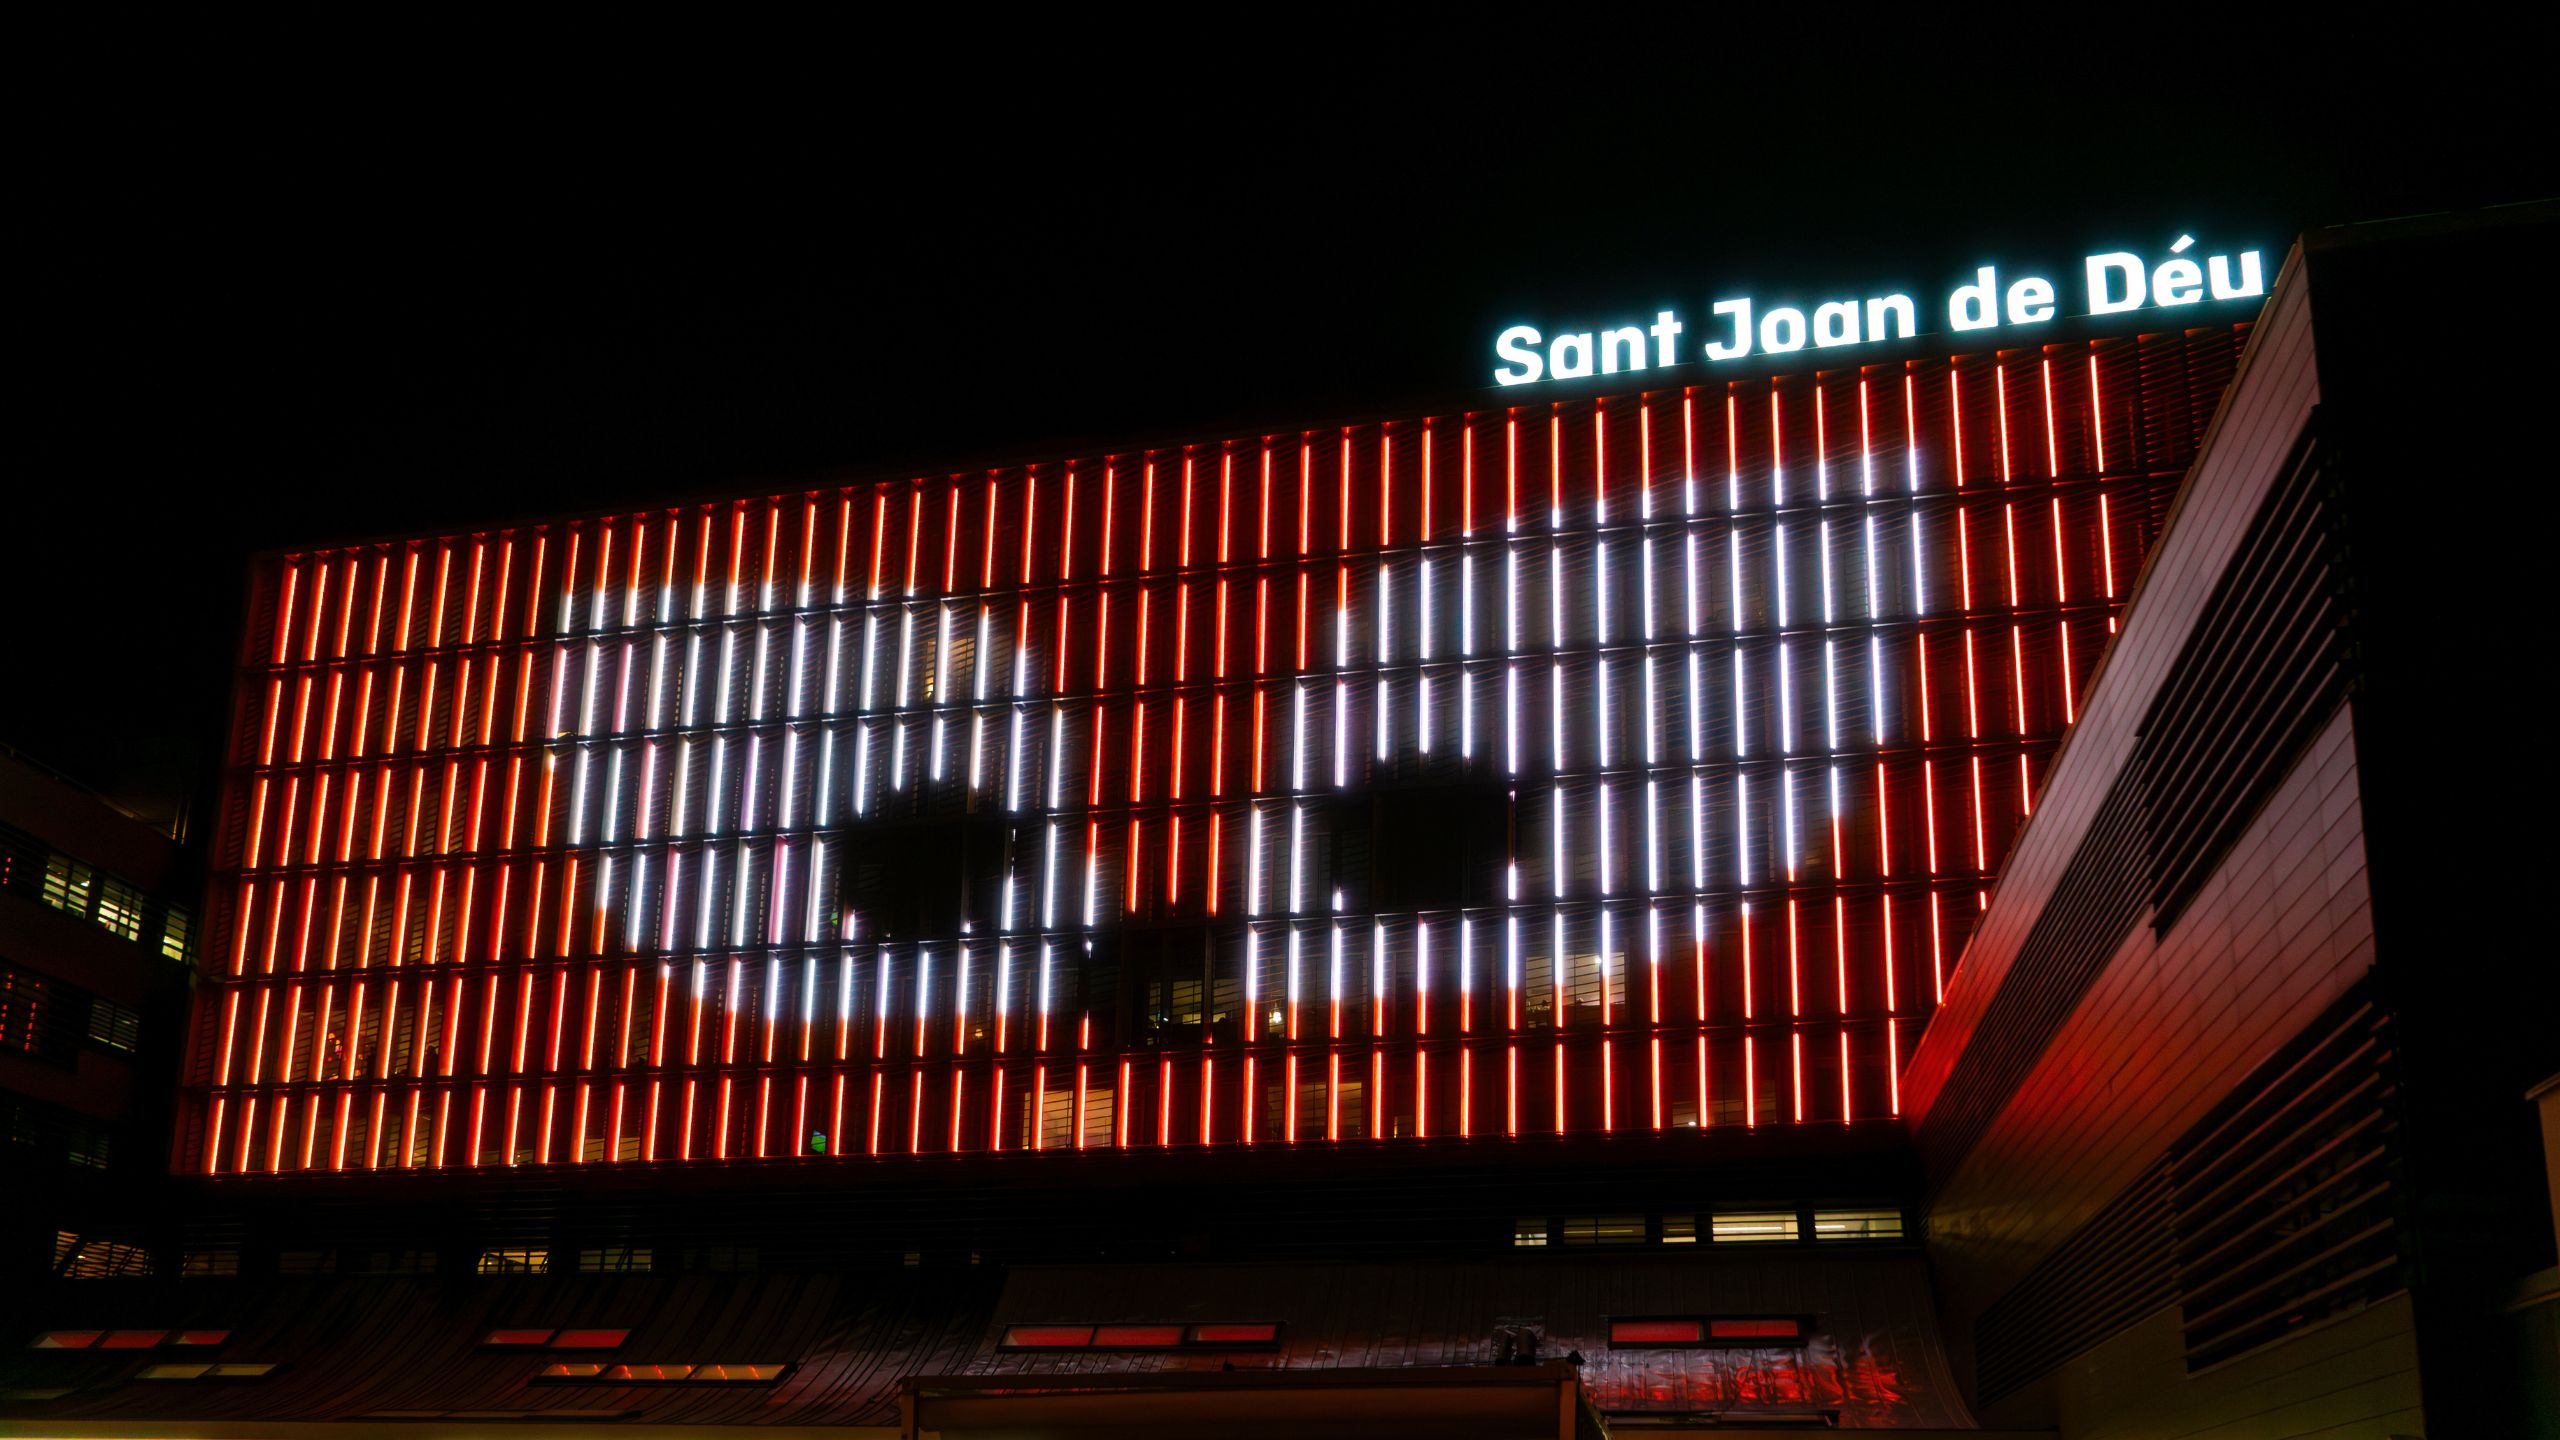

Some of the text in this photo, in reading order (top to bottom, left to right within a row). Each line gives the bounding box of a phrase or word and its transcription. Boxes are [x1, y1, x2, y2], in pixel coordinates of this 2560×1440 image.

[1494, 234, 2264, 387] Sant Joan de Déu
